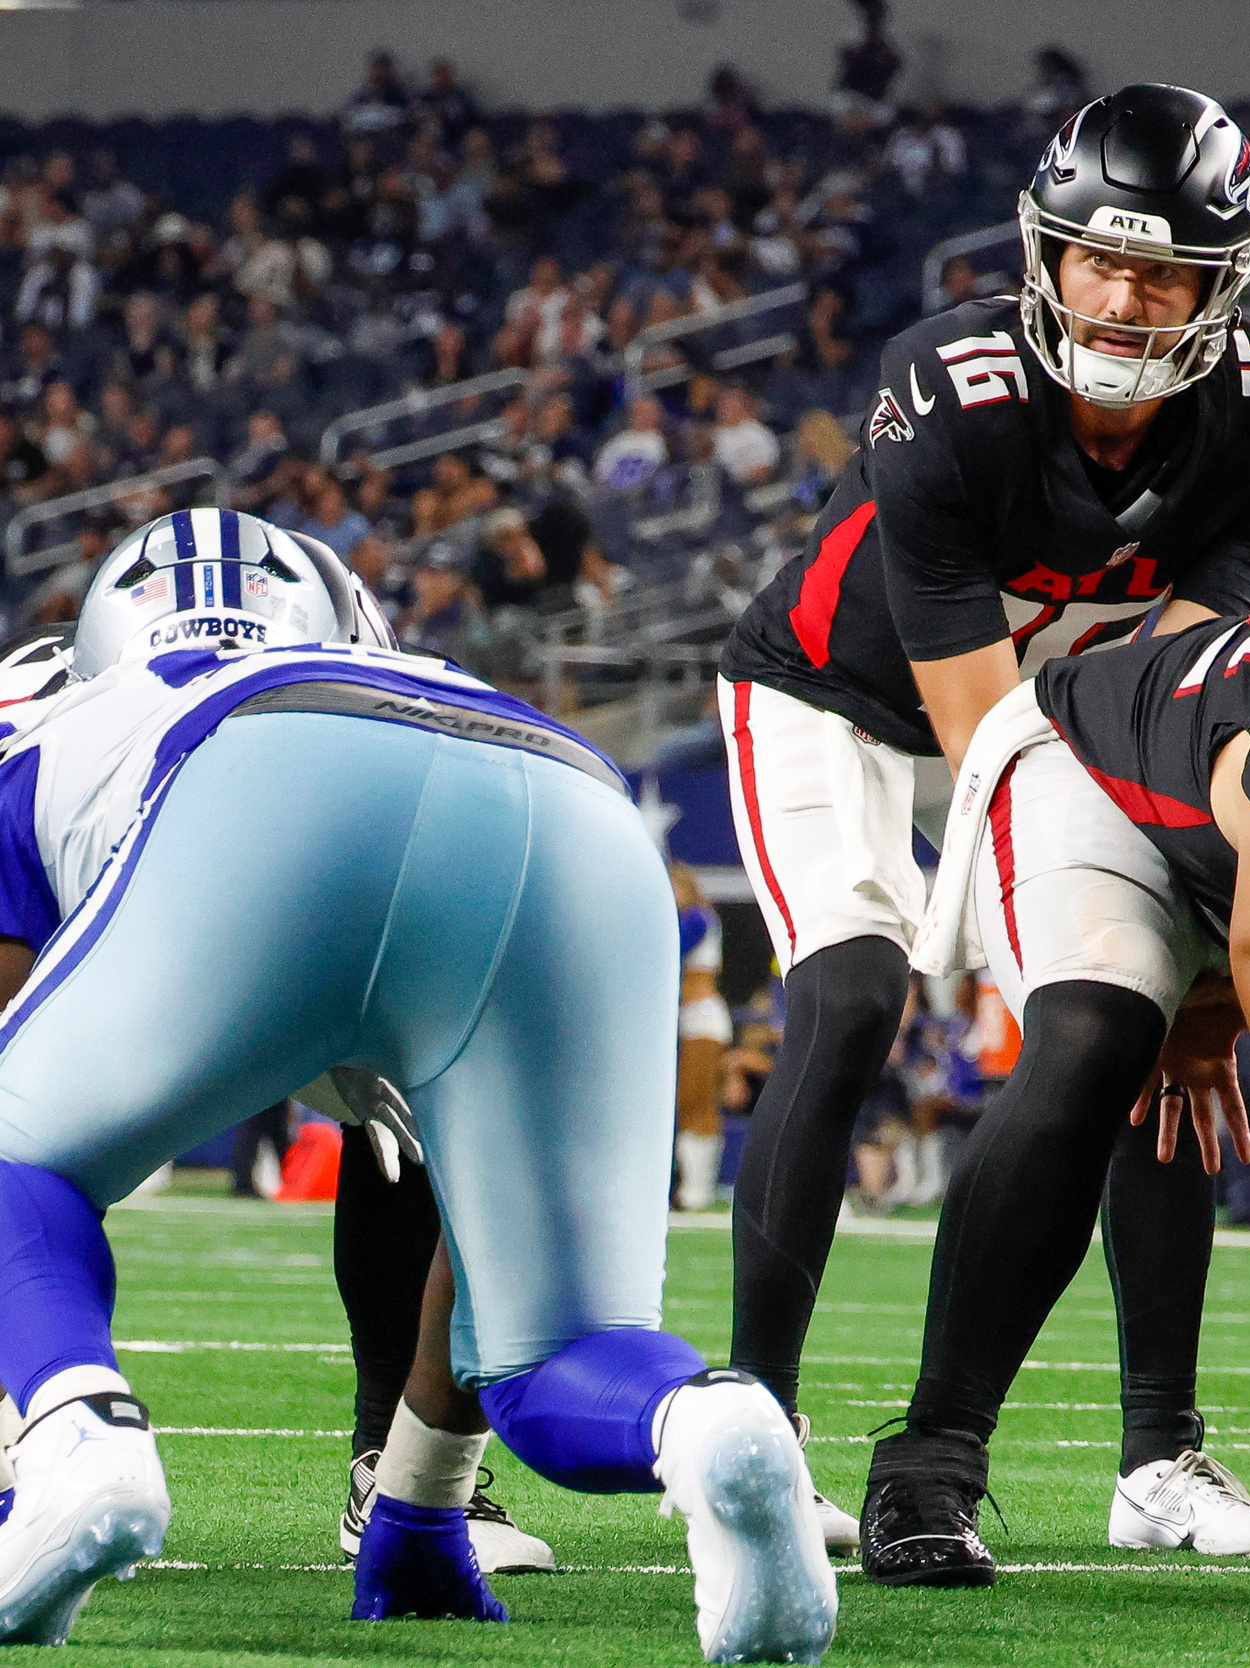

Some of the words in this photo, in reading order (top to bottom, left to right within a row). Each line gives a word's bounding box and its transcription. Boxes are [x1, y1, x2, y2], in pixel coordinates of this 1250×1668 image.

[1109, 215, 1152, 235] ATL
[936, 330, 1030, 410] 16
[248, 580, 268, 595] NFL
[150, 617, 268, 648] COWBOYS
[464, 721, 551, 747] PRO
